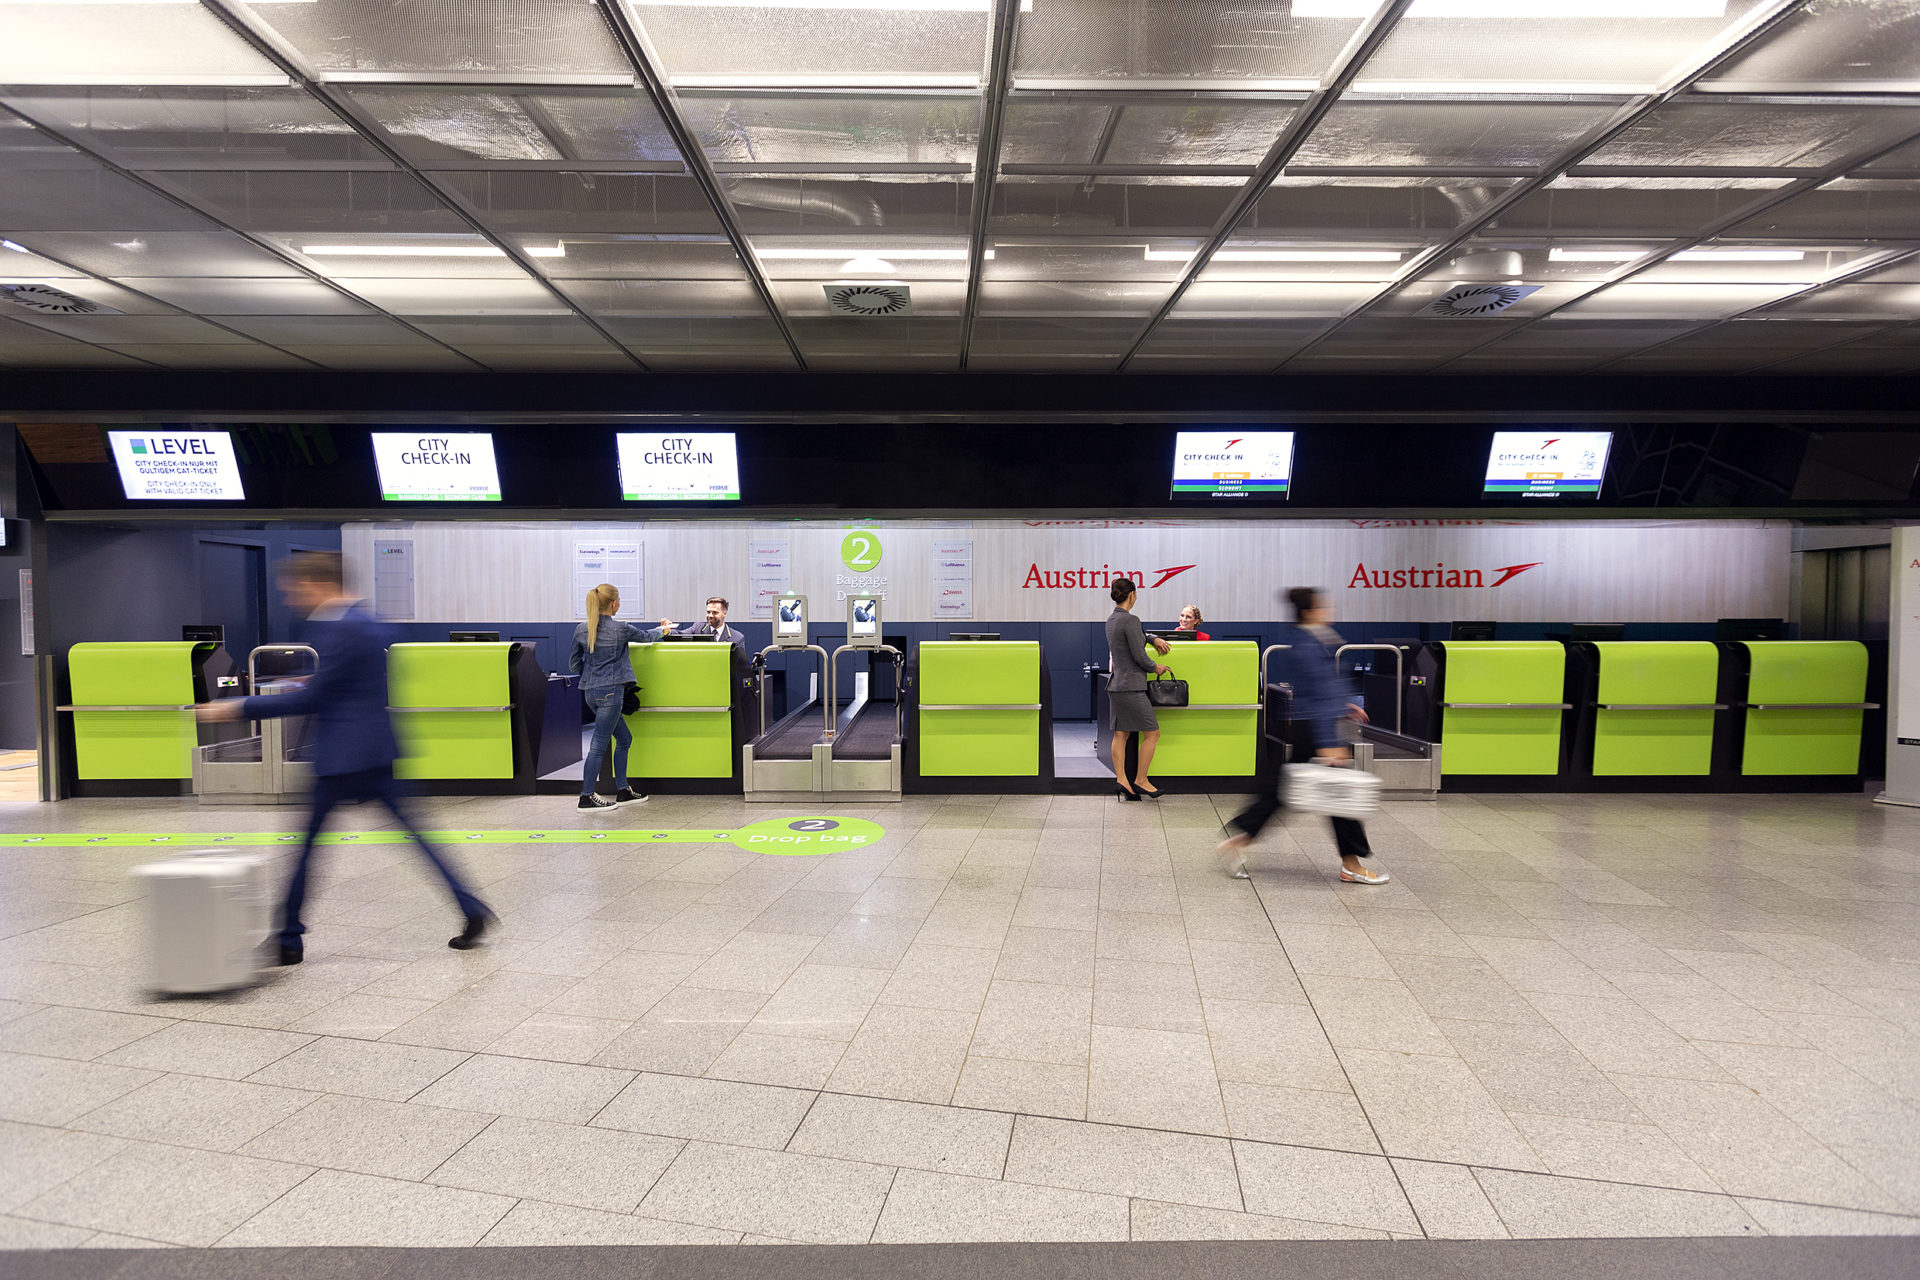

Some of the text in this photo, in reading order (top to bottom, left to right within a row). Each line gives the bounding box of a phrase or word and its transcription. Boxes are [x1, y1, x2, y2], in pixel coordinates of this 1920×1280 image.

[150, 438, 215, 455] LEVEL
[418, 438, 449, 451] CITY
[661, 438, 693, 451] CITY
[401, 452, 472, 465] CHECK-IN
[644, 452, 714, 465] CHECK-IN
[851, 537, 872, 565] 2
[835, 574, 888, 589] Baggage
[1347, 562, 1485, 589] Austrian
[799, 820, 827, 830] 2
[748, 834, 867, 844] Drop bag
